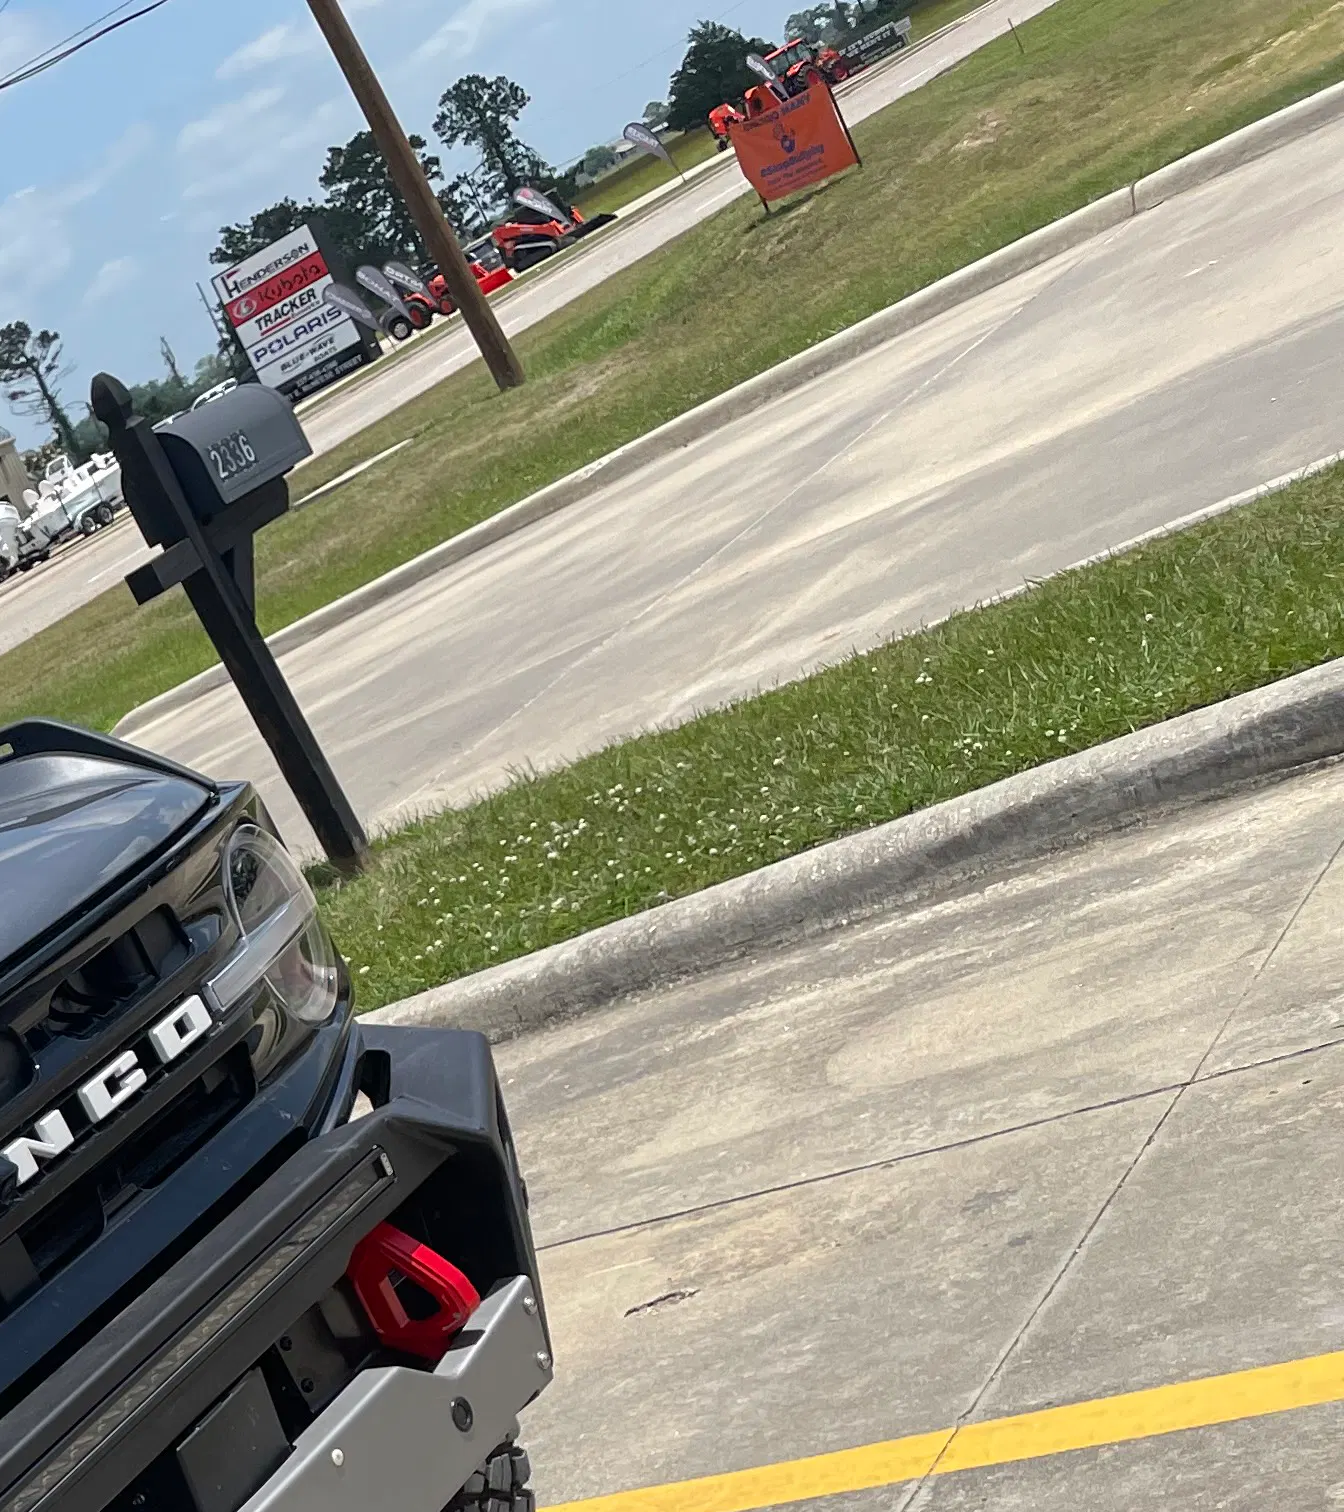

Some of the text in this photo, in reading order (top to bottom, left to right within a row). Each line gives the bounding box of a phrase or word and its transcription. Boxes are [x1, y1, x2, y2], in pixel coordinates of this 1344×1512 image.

[220, 242, 310, 299] HENDERSON
[258, 263, 322, 302] Kubota
[254, 287, 318, 332] TRACKER
[254, 306, 343, 363] POLARIS
[210, 435, 255, 478] 2336
